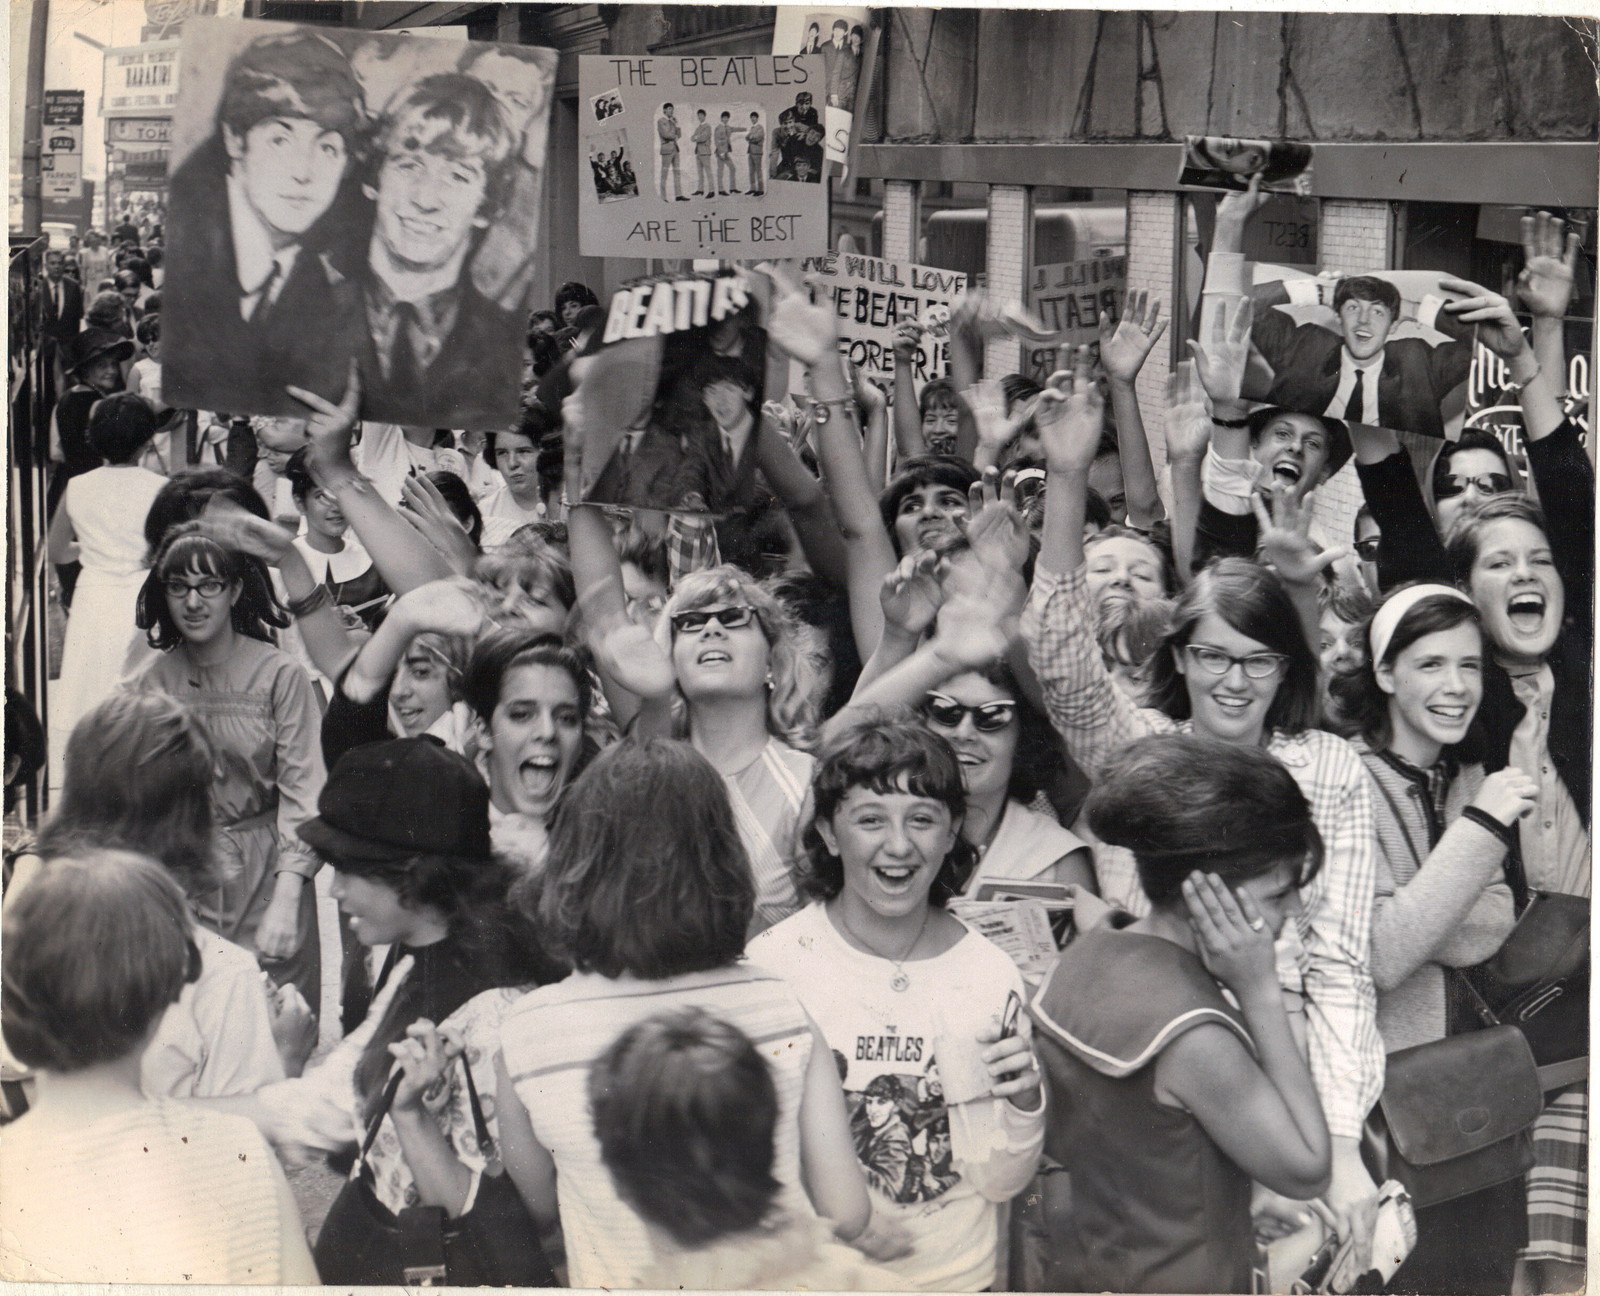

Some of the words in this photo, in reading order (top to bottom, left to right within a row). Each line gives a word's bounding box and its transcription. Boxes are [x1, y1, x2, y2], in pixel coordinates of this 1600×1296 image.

[608, 59, 656, 86] THE
[681, 54, 808, 86] BEATLES
[53, 138, 72, 147] TAXI
[627, 220, 681, 242] ARE
[692, 218, 741, 243] THE
[751, 215, 802, 242] BEST
[845, 255, 905, 288] WILL
[856, 1035, 923, 1062] BEATLES
